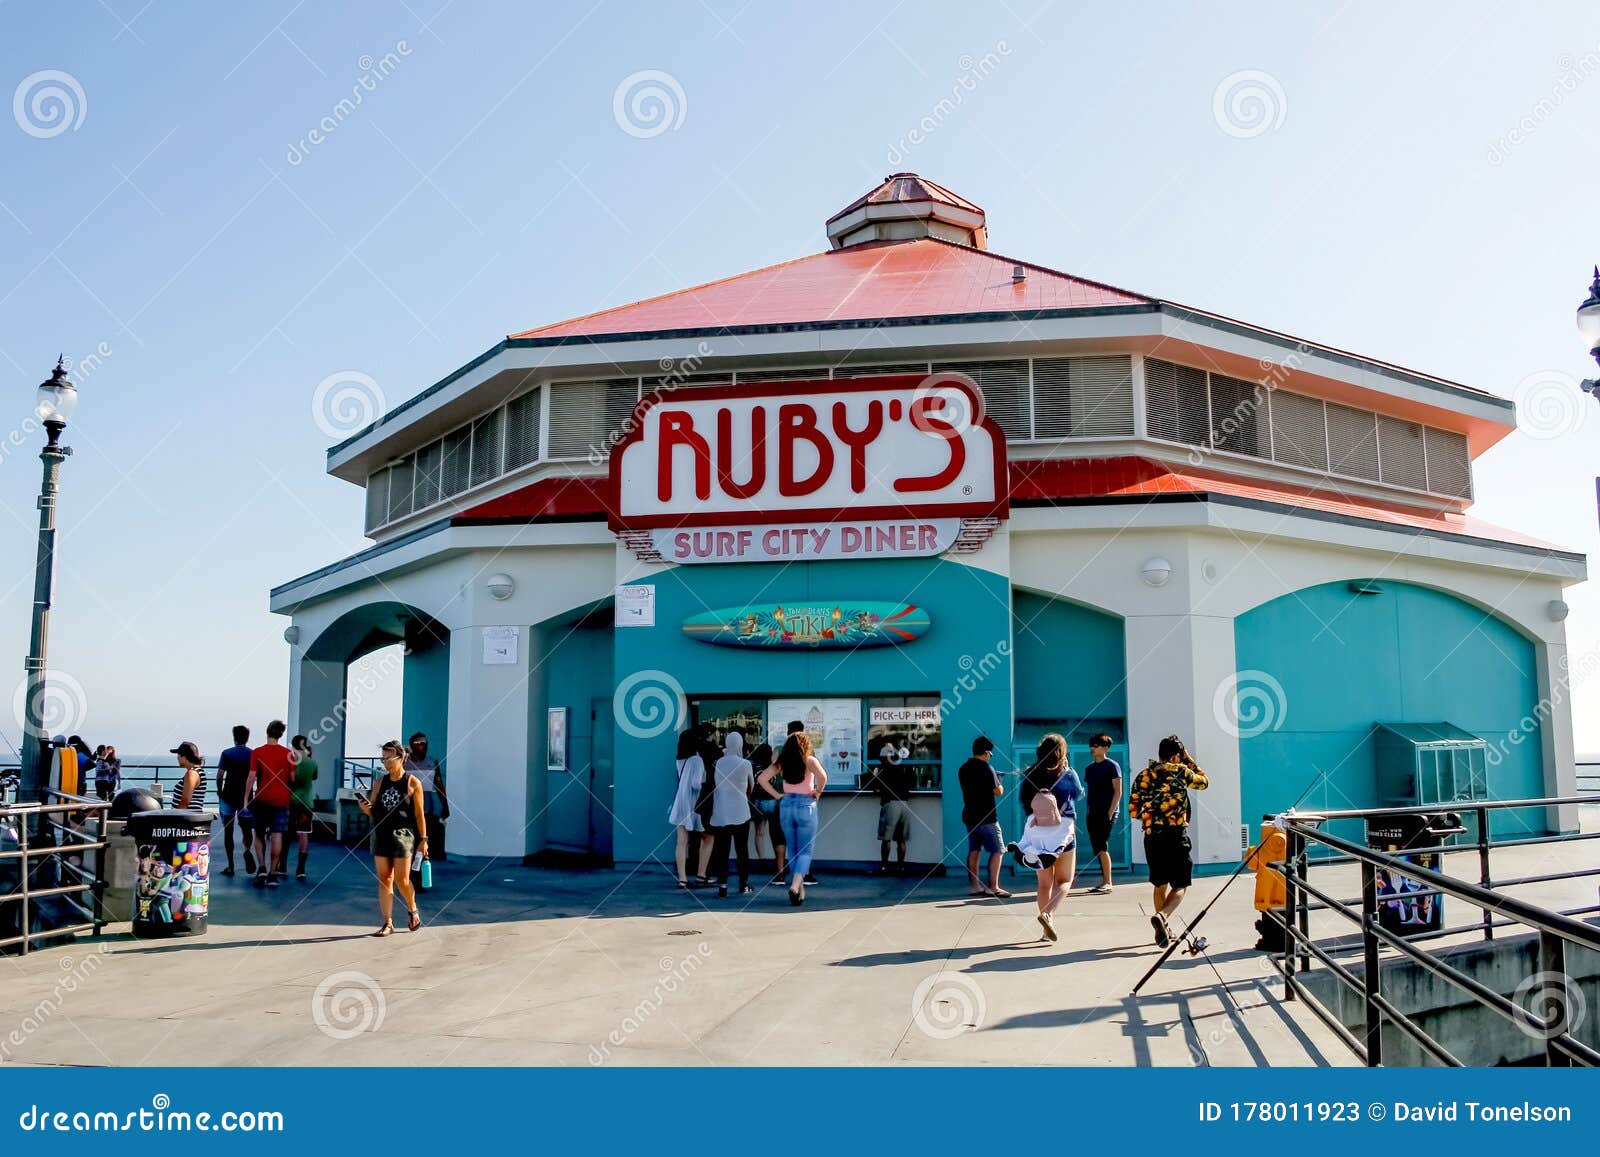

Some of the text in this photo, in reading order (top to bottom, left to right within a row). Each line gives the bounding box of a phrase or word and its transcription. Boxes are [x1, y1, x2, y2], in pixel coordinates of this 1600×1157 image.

[657, 398, 966, 502] RUBY'S
[673, 524, 938, 559] SURF CITY DINER
[786, 616, 826, 636] TIKI
[874, 711, 937, 720] PICK-UP HERE
